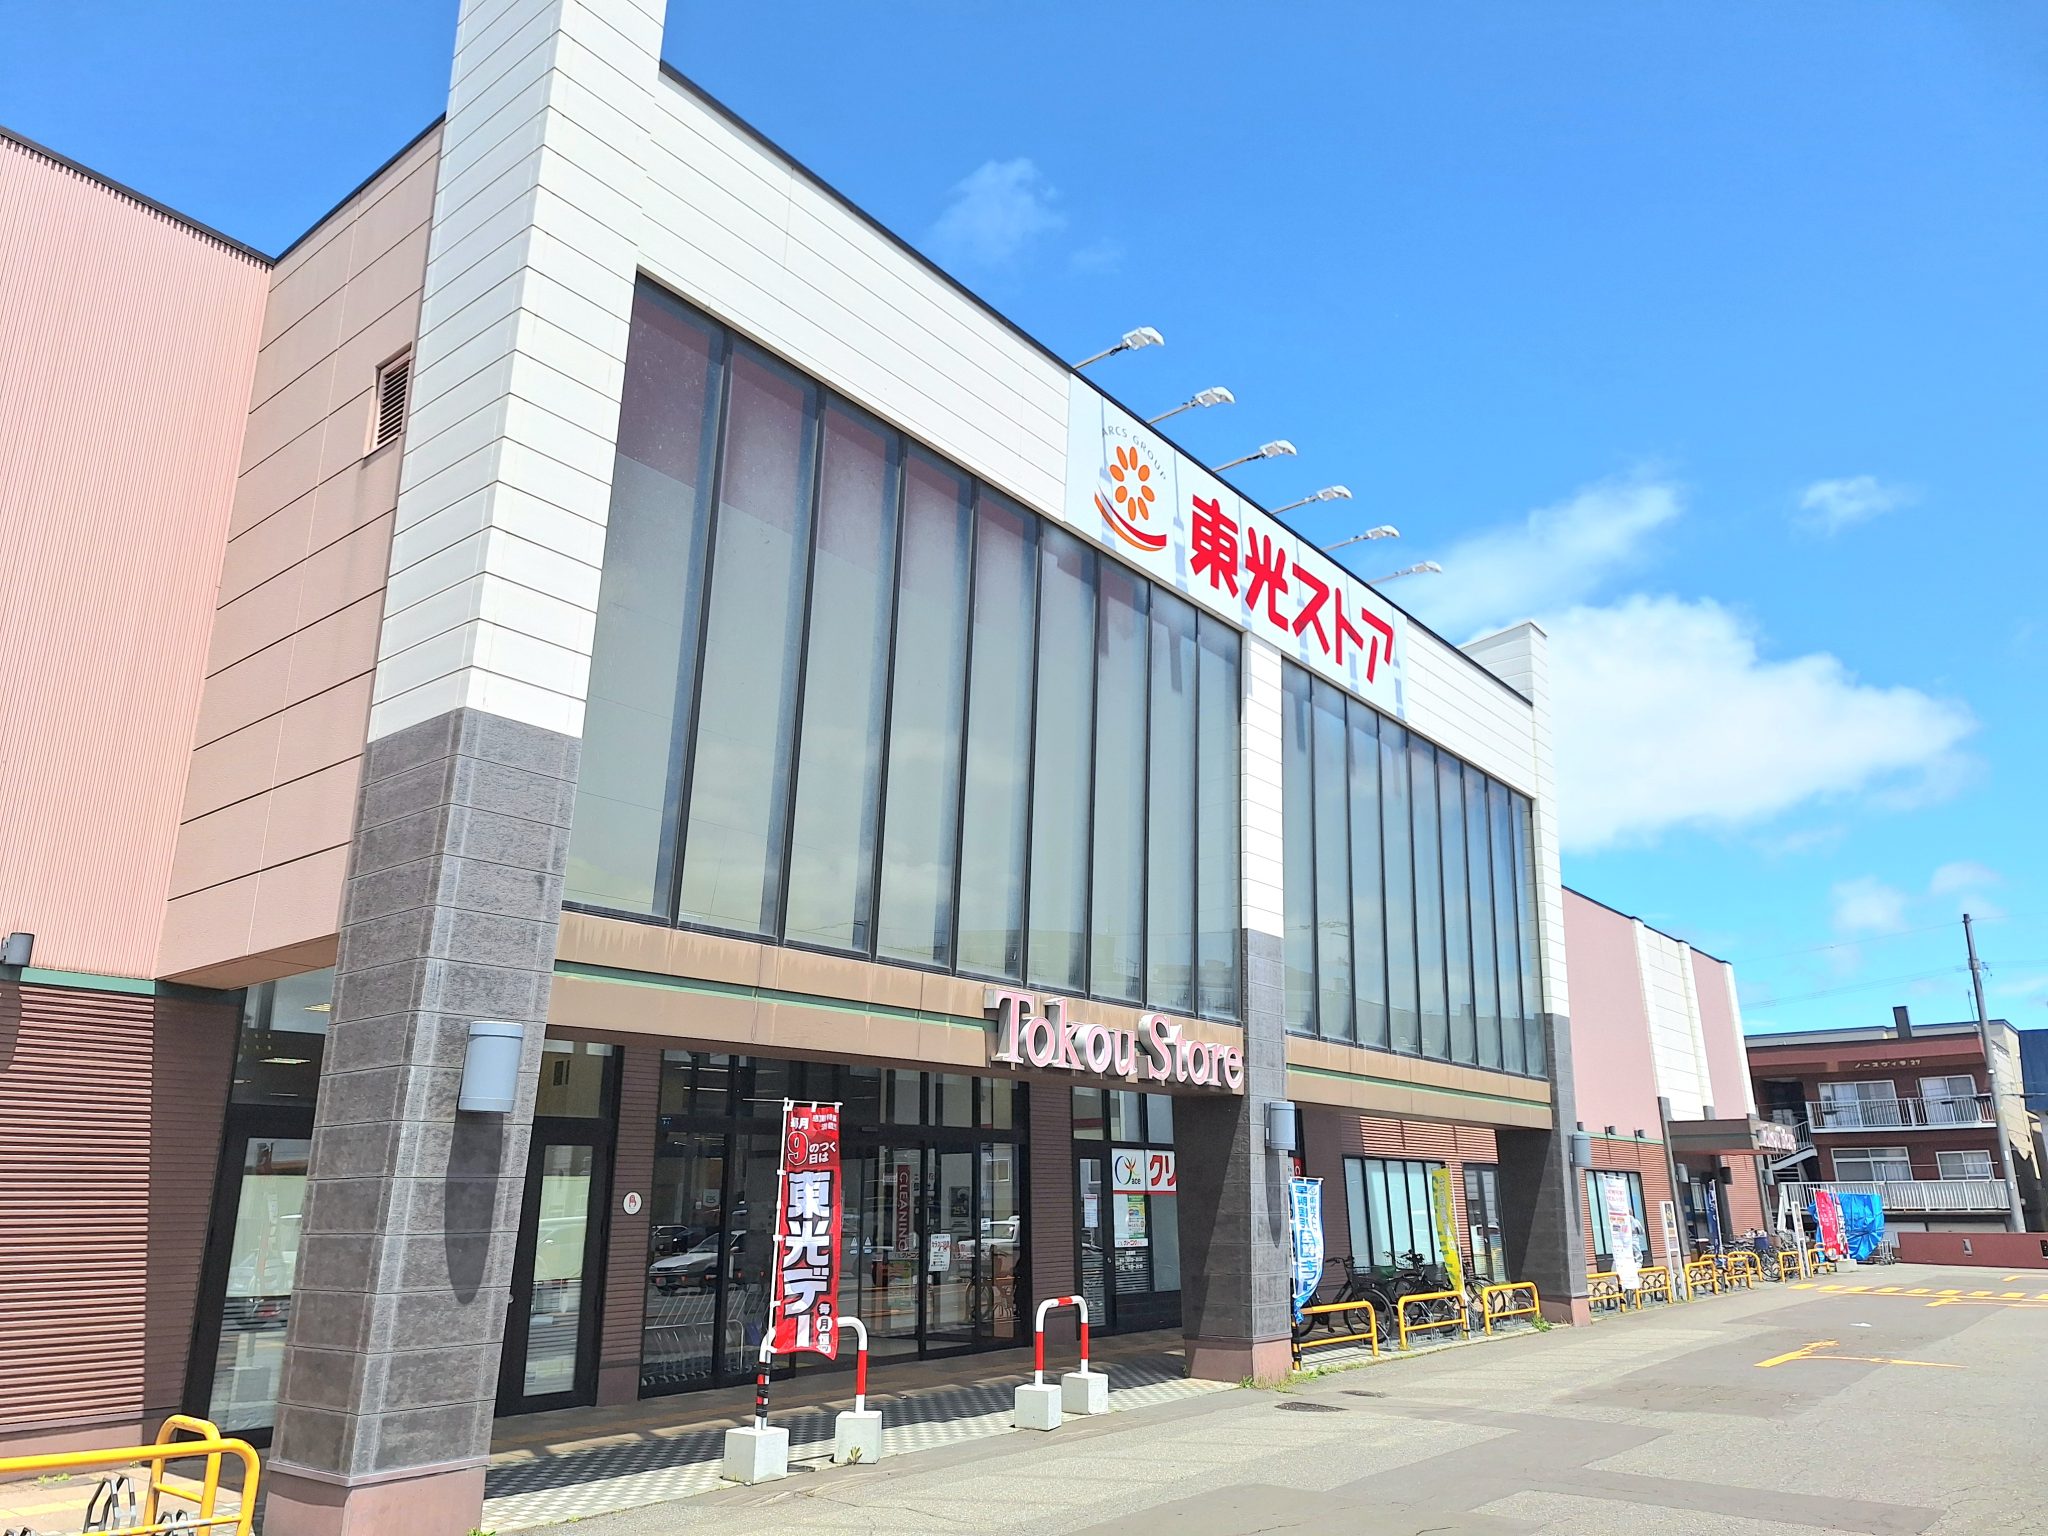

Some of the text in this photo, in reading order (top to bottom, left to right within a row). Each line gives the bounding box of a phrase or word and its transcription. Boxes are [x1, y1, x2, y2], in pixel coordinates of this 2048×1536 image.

[1102, 426, 1128, 438] ARCS
[1190, 494, 1394, 684] 東光ストア
[988, 989, 1244, 1089] Tokou Store
[787, 1131, 809, 1166] 9
[808, 1152, 829, 1165] 日は
[782, 1171, 831, 1348] 東光デー
